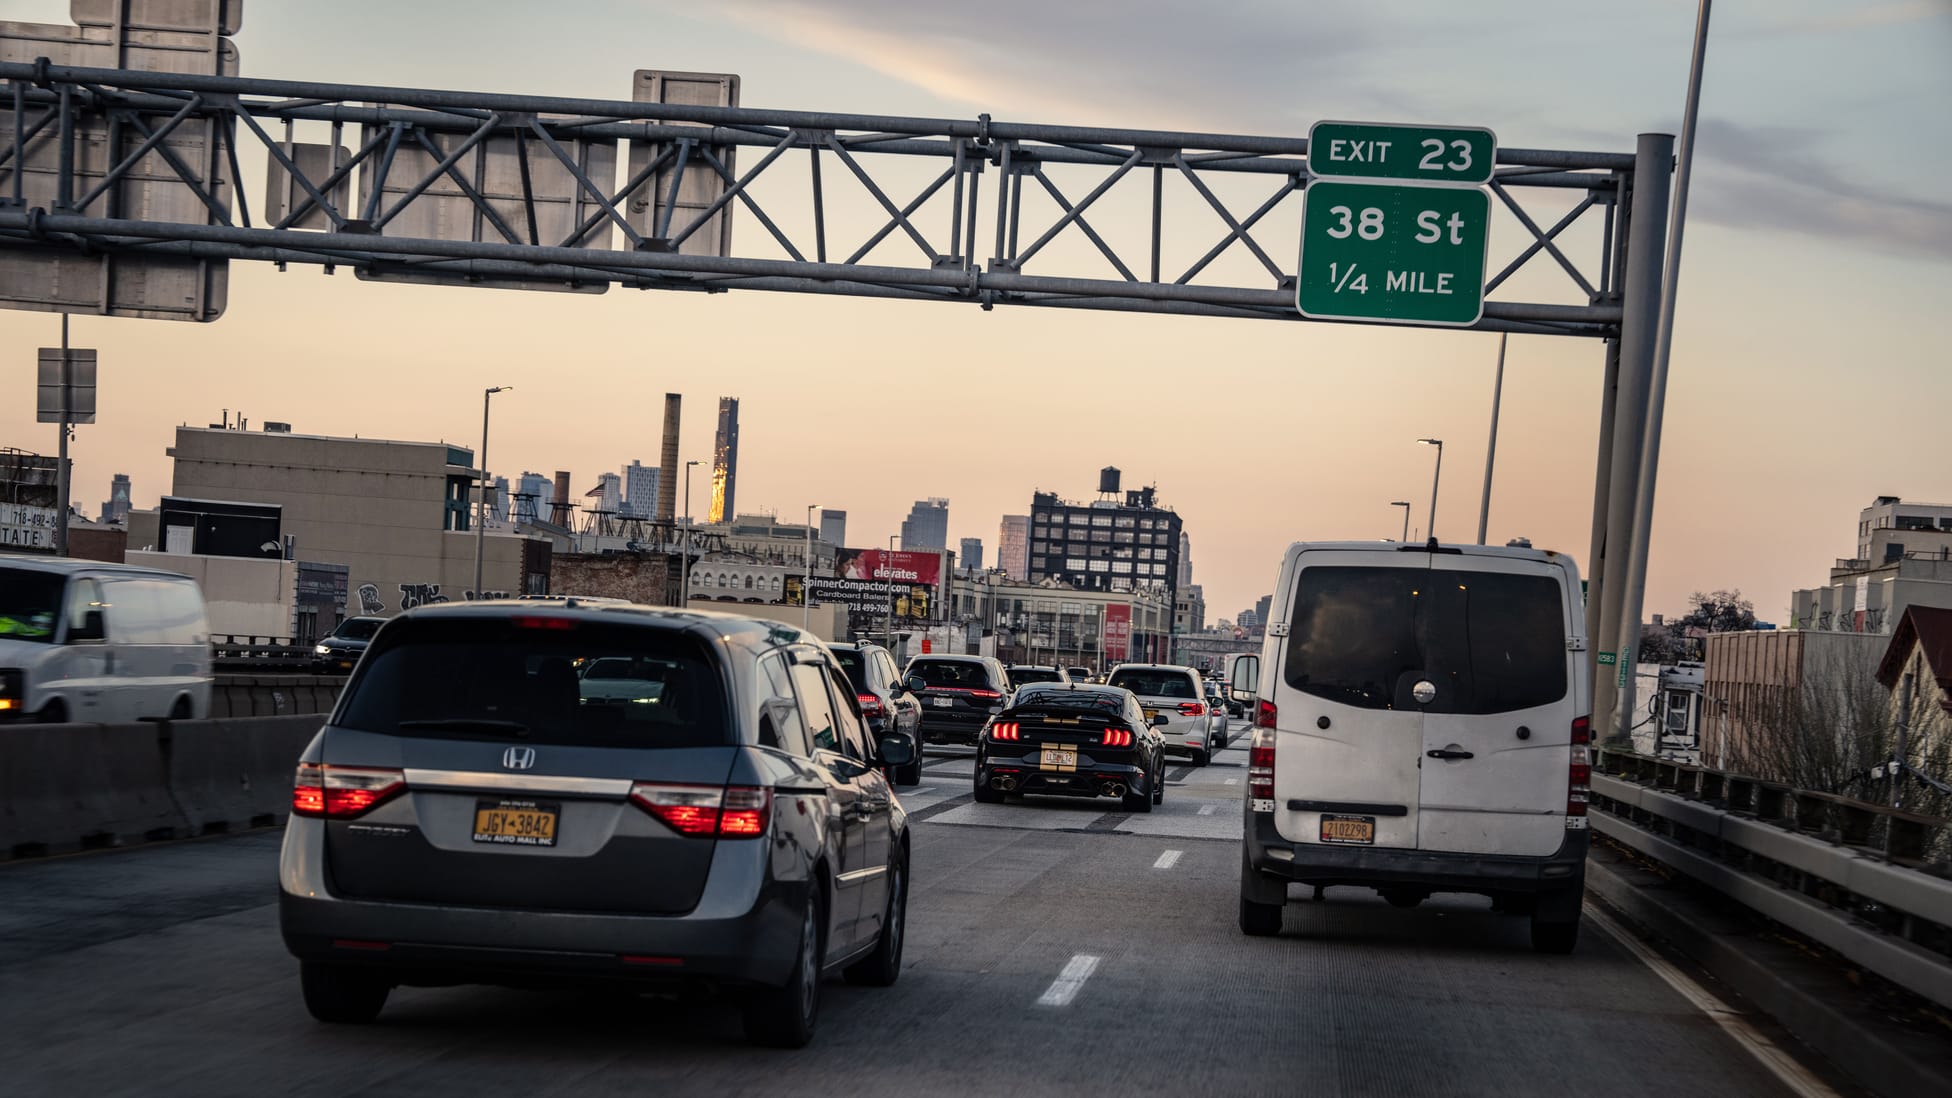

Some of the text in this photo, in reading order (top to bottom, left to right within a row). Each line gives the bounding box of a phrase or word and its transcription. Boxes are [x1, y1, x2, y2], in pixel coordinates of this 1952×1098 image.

[1329, 138, 1473, 171] EXIT 23
[1326, 205, 1465, 245] 38 St
[1385, 270, 1454, 295] MILE
[2, 528, 39, 545] TATE
[816, 590, 861, 600] Cardboard
[862, 603, 893, 613] 499-760
[493, 834, 516, 843] AUTO
[516, 836, 537, 844] MALL
[538, 837, 553, 845] INC
